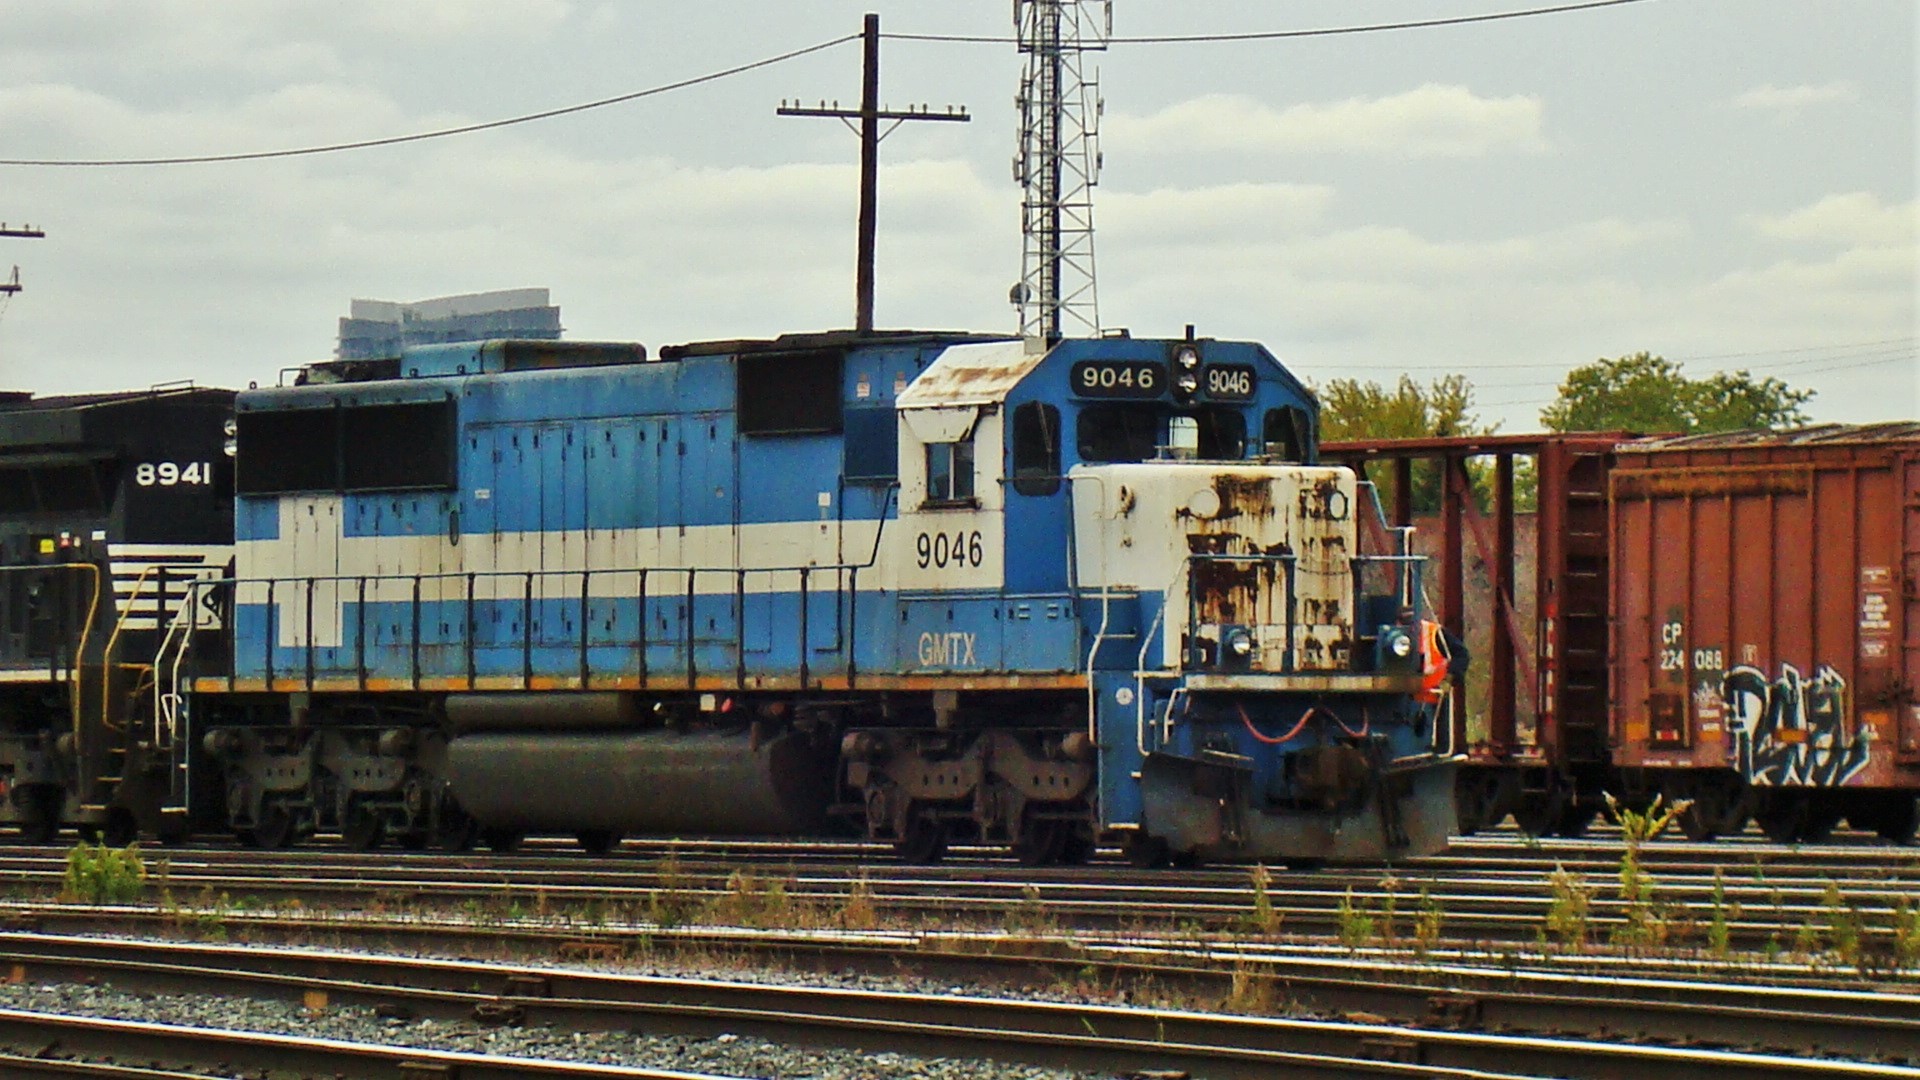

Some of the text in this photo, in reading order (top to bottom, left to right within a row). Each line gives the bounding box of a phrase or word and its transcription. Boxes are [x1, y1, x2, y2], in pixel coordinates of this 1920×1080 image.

[1083, 367, 1154, 388] 9046
[1209, 369, 1250, 394] 9046
[136, 462, 210, 486] 8941
[917, 531, 982, 569] 9046
[1663, 623, 1682, 645] CP
[918, 632, 976, 666] GMTX
